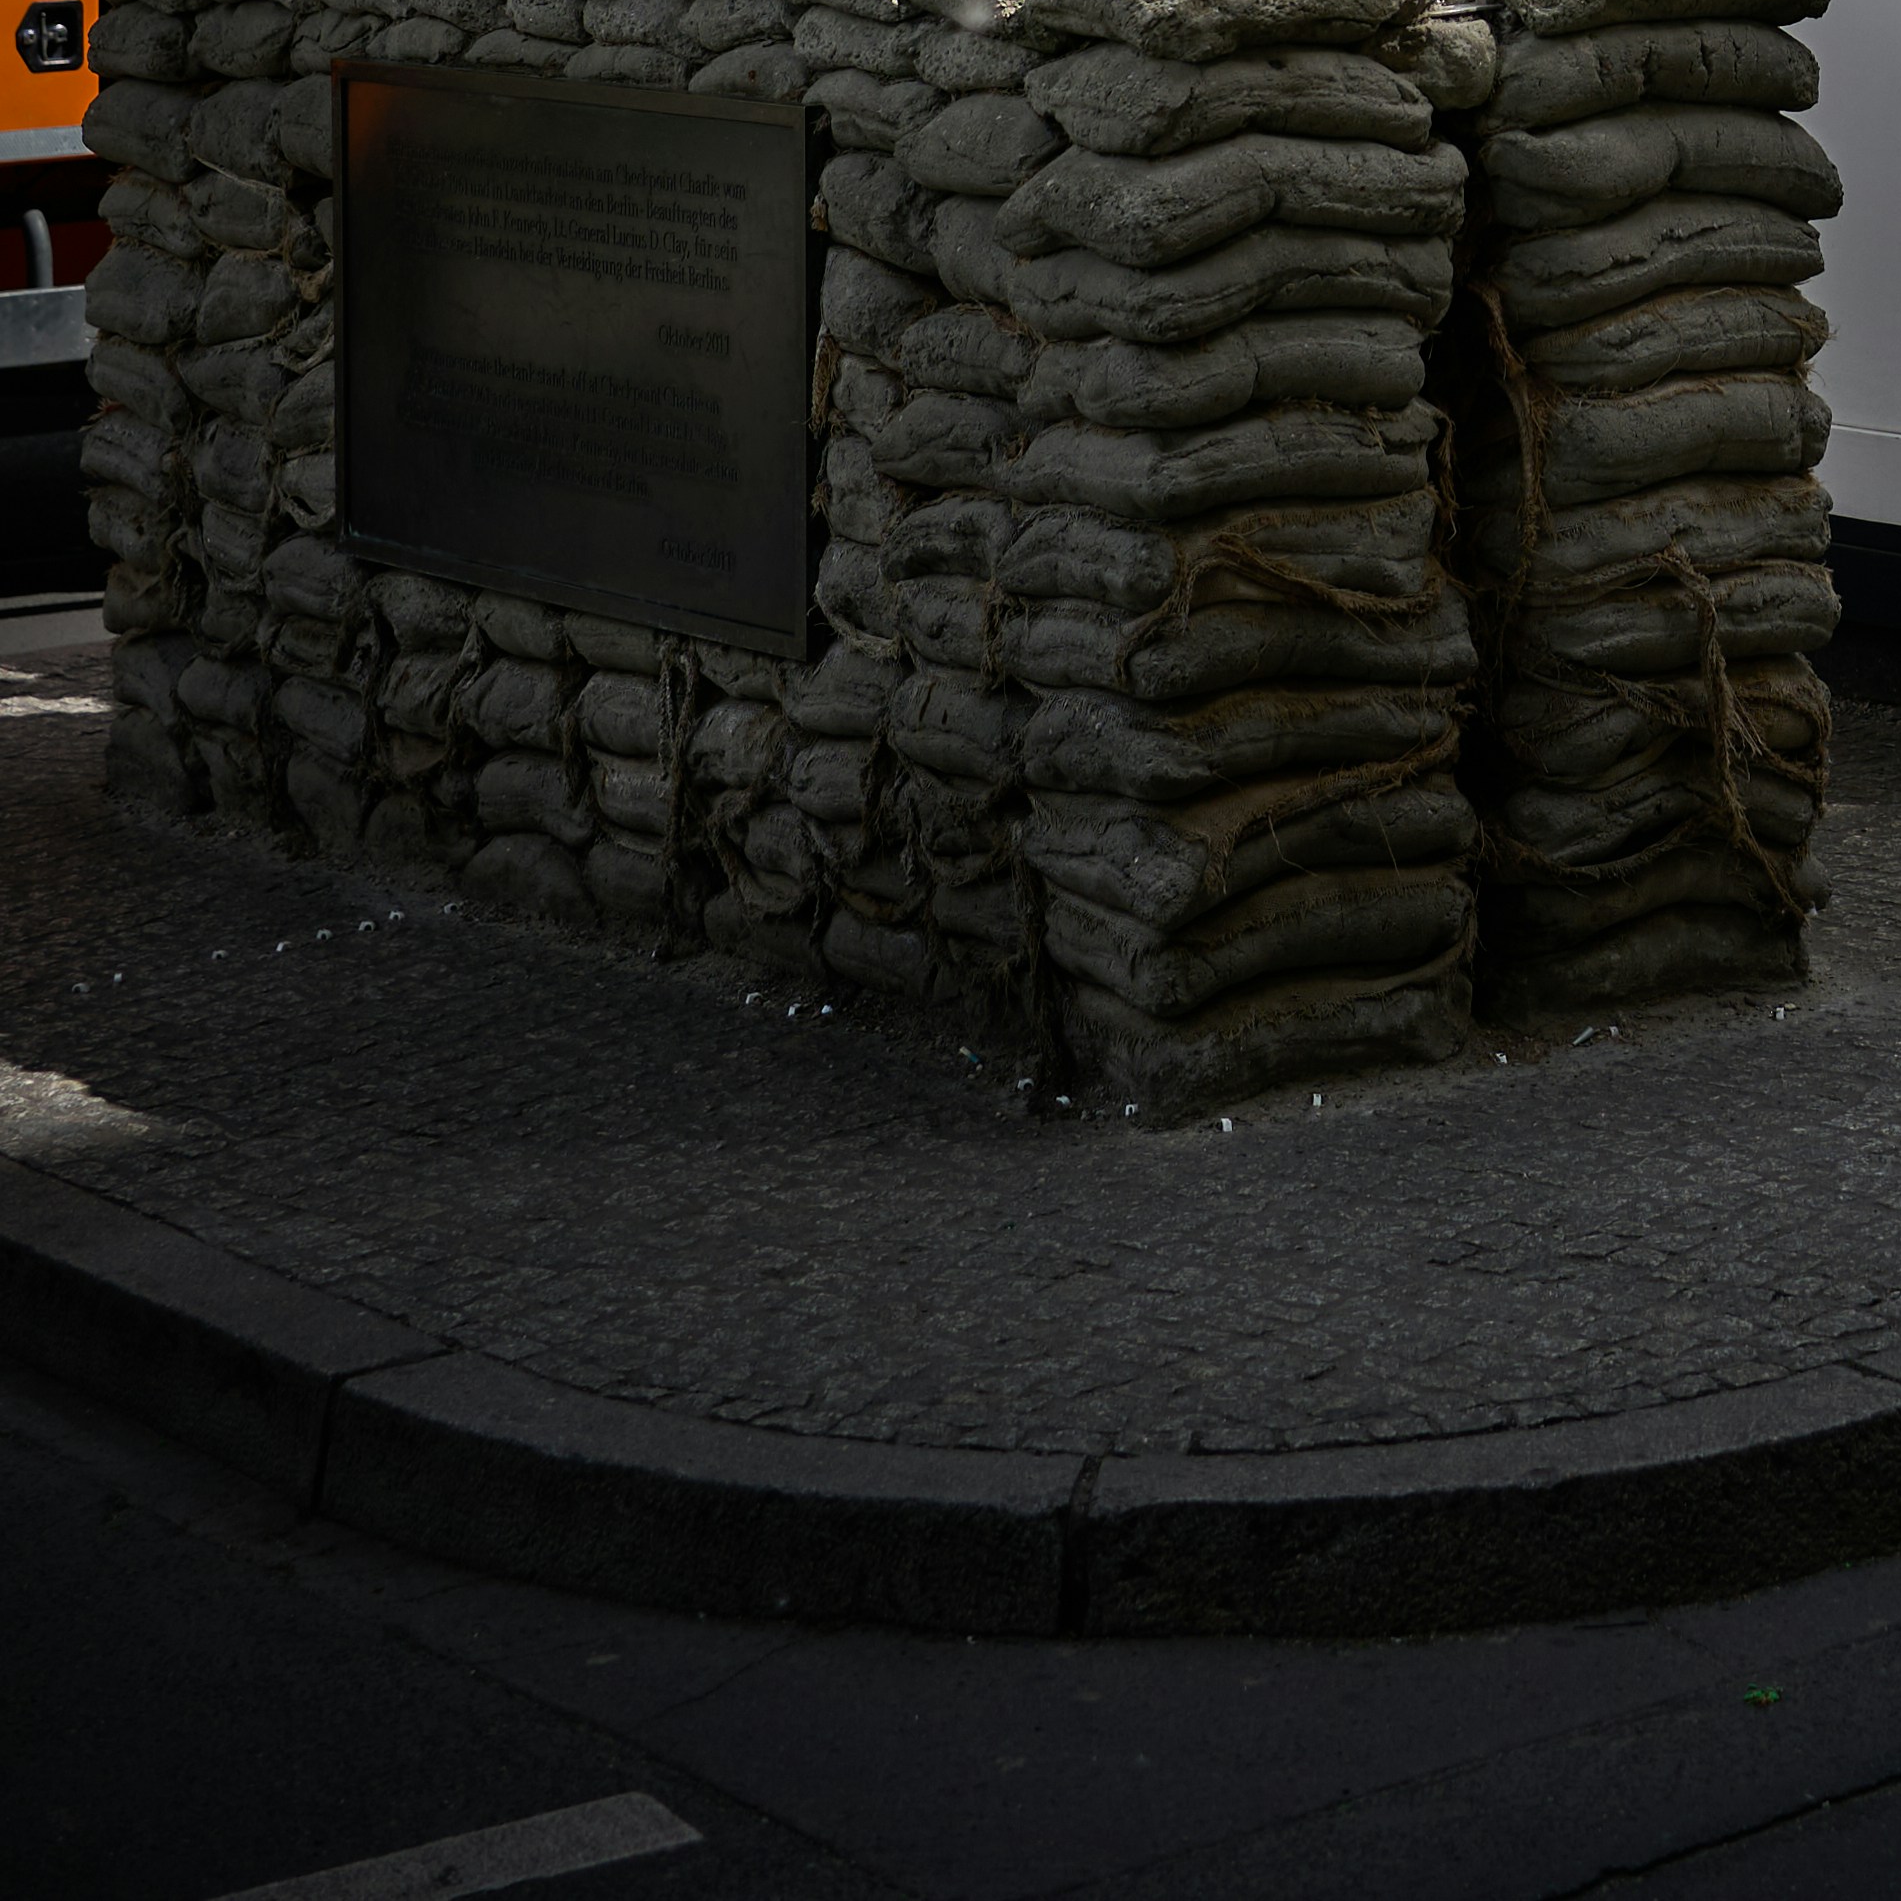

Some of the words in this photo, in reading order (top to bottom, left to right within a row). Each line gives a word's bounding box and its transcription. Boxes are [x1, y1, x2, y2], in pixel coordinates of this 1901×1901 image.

[616, 163, 677, 195] Checkpoint
[680, 171, 720, 197] Charlie
[724, 183, 746, 201] vom
[570, 195, 582, 211] an
[585, 189, 604, 212] den
[719, 207, 738, 231] des
[474, 236, 516, 261] Handeln
[519, 241, 534, 263] bei
[537, 244, 553, 265] der
[556, 247, 623, 284] Verteidigung
[625, 256, 642, 279] der
[646, 260, 686, 286] Freiheit
[569, 219, 610, 245] General
[613, 224, 647, 250] Lucius
[694, 234, 712, 258] für
[714, 240, 738, 262] sein
[658, 324, 703, 350] Oktober
[706, 331, 731, 356] 2011
